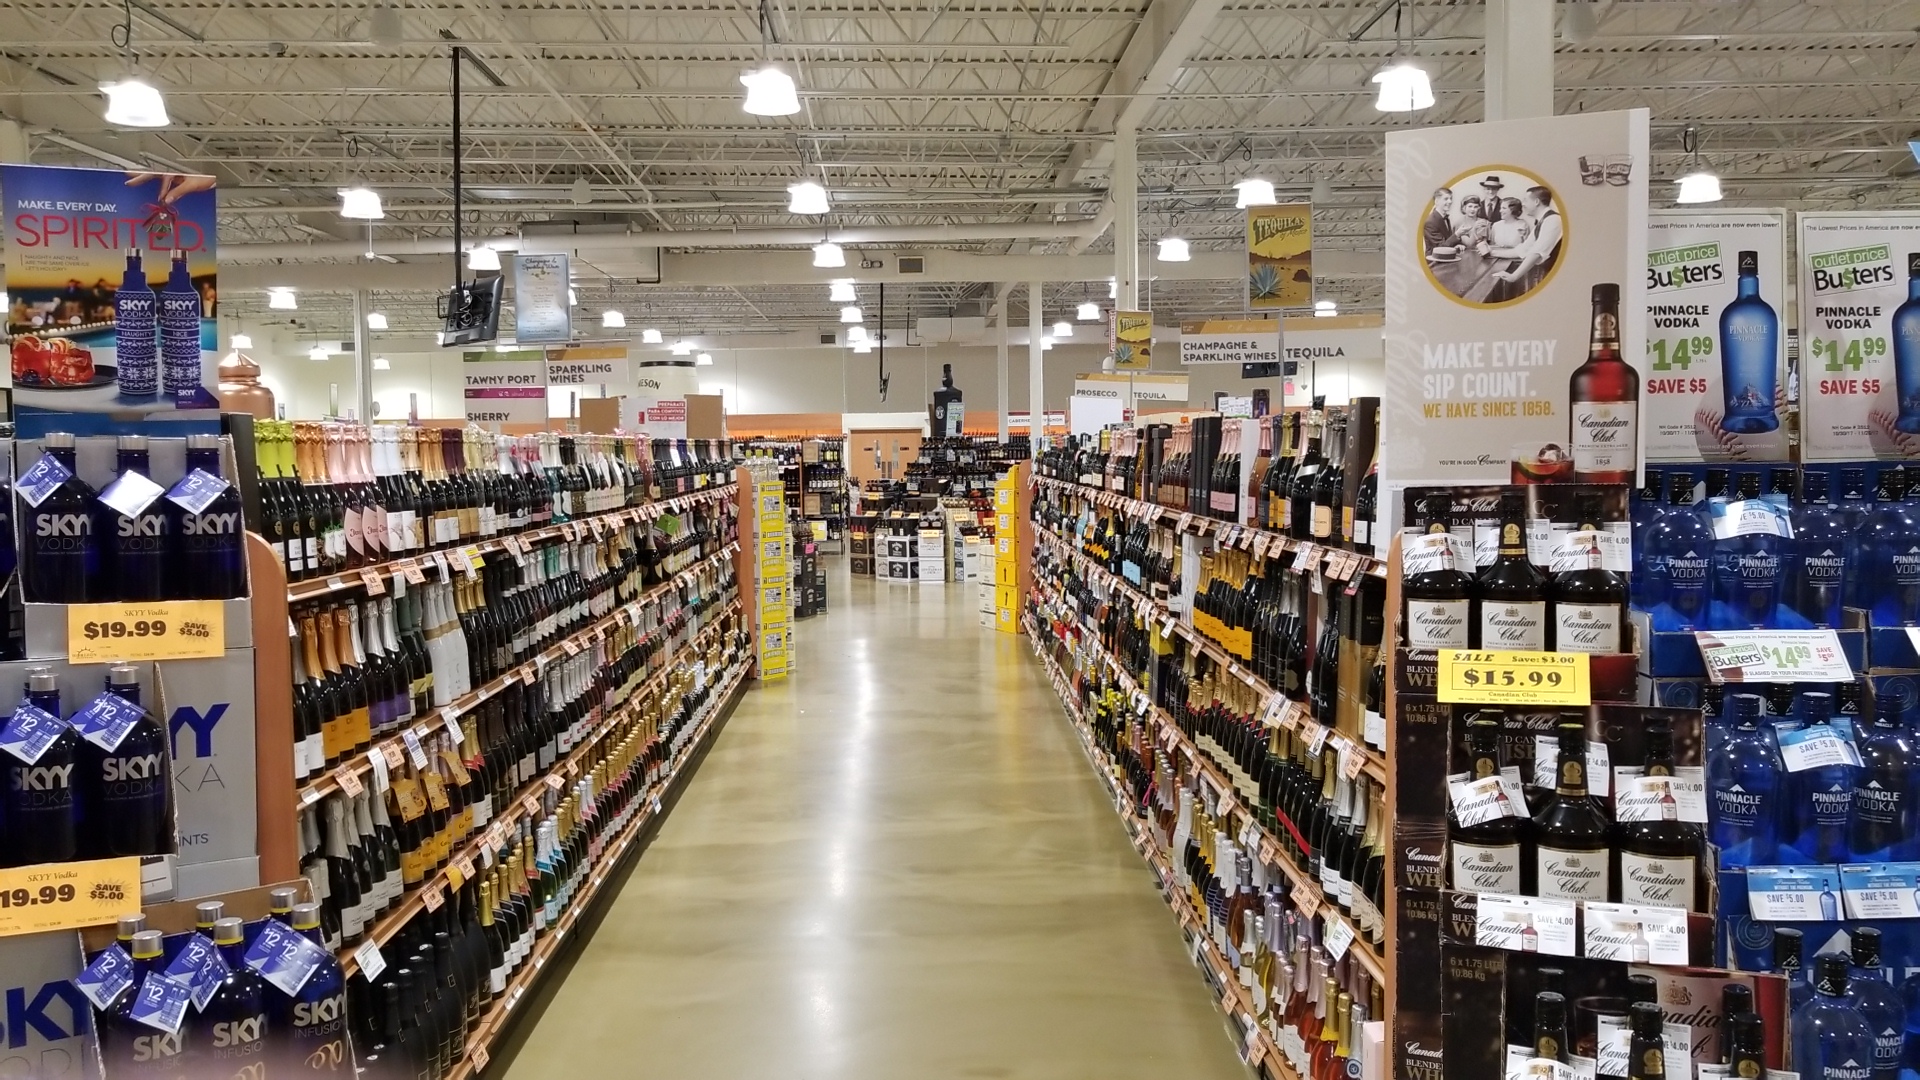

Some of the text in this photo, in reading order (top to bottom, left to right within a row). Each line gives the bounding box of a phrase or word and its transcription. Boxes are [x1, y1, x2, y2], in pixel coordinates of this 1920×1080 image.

[18, 199, 117, 213] MAKE. EVERY DAY.
[1696, 221, 1720, 229] America
[15, 213, 207, 253] SPIRITED.
[1683, 246, 1717, 262] price
[1814, 248, 1887, 269] outlet price
[1813, 264, 1894, 292] Bu$ters
[119, 300, 151, 311] SKYY
[164, 299, 196, 311] SKYY
[1647, 305, 1710, 316] PINNACLE
[119, 310, 152, 318] VODKA
[1815, 306, 1882, 318] PINNACLE
[1654, 317, 1700, 329] VODKA
[1825, 318, 1872, 330] VODKA
[1729, 325, 1768, 335] PINNACLE
[1183, 341, 1258, 351] CHAMPAGNE &
[1183, 351, 1277, 362] SPARKLING WINES
[1285, 346, 1345, 359] TEQUILA
[1423, 339, 1558, 370] MAKE EVERY
[549, 363, 612, 375] SPARKLING
[466, 374, 537, 385] TAWNY PORT
[549, 373, 585, 385] WINES
[1423, 371, 1537, 399] SIP COUNT.
[1647, 378, 1707, 395] SAVE $5
[1819, 379, 1881, 396] SAVE $5
[1076, 389, 1118, 397] PROSECCO
[1133, 391, 1167, 399] TEQUILA
[1423, 400, 1555, 418] WE HAVE SINCE 1858.
[467, 412, 511, 422] SHERRY
[1578, 413, 1630, 428] Canadian
[182, 512, 238, 535] SKYY
[1600, 536, 1613, 545] SAVE
[1668, 558, 1709, 568] PINNACLE
[1739, 557, 1779, 568] PINNACLE
[1805, 557, 1845, 567] PINNACLE
[1671, 568, 1706, 578] VODKA
[1741, 567, 1776, 578] VODKA
[1807, 567, 1843, 577] VODKA
[1413, 611, 1463, 626] Canadian
[1487, 612, 1537, 628] Canadian
[1560, 614, 1612, 630] Canadian
[83, 619, 167, 640] $19.99
[183, 621, 207, 630] SAVE
[178, 627, 210, 638] $5.00
[1453, 653, 1576, 664] SALE Save: $3.00
[1713, 652, 1762, 667] Bu$ters
[1463, 667, 1563, 688] $15.99
[1419, 704, 1434, 713] 1.75
[1405, 714, 1438, 725] 10.86 kg
[1799, 742, 1818, 753] SAVE
[102, 752, 163, 782] SKYY
[11, 763, 75, 791] SKYY
[1673, 781, 1685, 792] SAVE
[1715, 790, 1762, 805] PINNACLE
[1812, 792, 1852, 803] PINNACLE
[1854, 786, 1901, 802] PINNACLE
[1718, 802, 1758, 815] VODKA
[1815, 803, 1850, 813] VODKA
[1856, 798, 1896, 812] VODKA
[1459, 855, 1514, 873] Canadian
[1545, 858, 1601, 880] Canadian
[27, 871, 79, 883] SKYY Vodka
[1628, 865, 1686, 887] Canadian
[94, 883, 122, 892] SAVE
[90, 890, 124, 900] $5.00
[1766, 894, 1784, 903] SAVE
[1860, 891, 1878, 901] SAVE
[1420, 901, 1435, 910] 1.75
[1406, 909, 1438, 921] 10.86 kg
[1537, 914, 1553, 924] SAVE
[1647, 923, 1664, 934] SAVE
[1466, 959, 1482, 968] 1.75
[1451, 968, 1486, 981] 10.86 kg
[1823, 1066, 1872, 1078] PINNACLE
